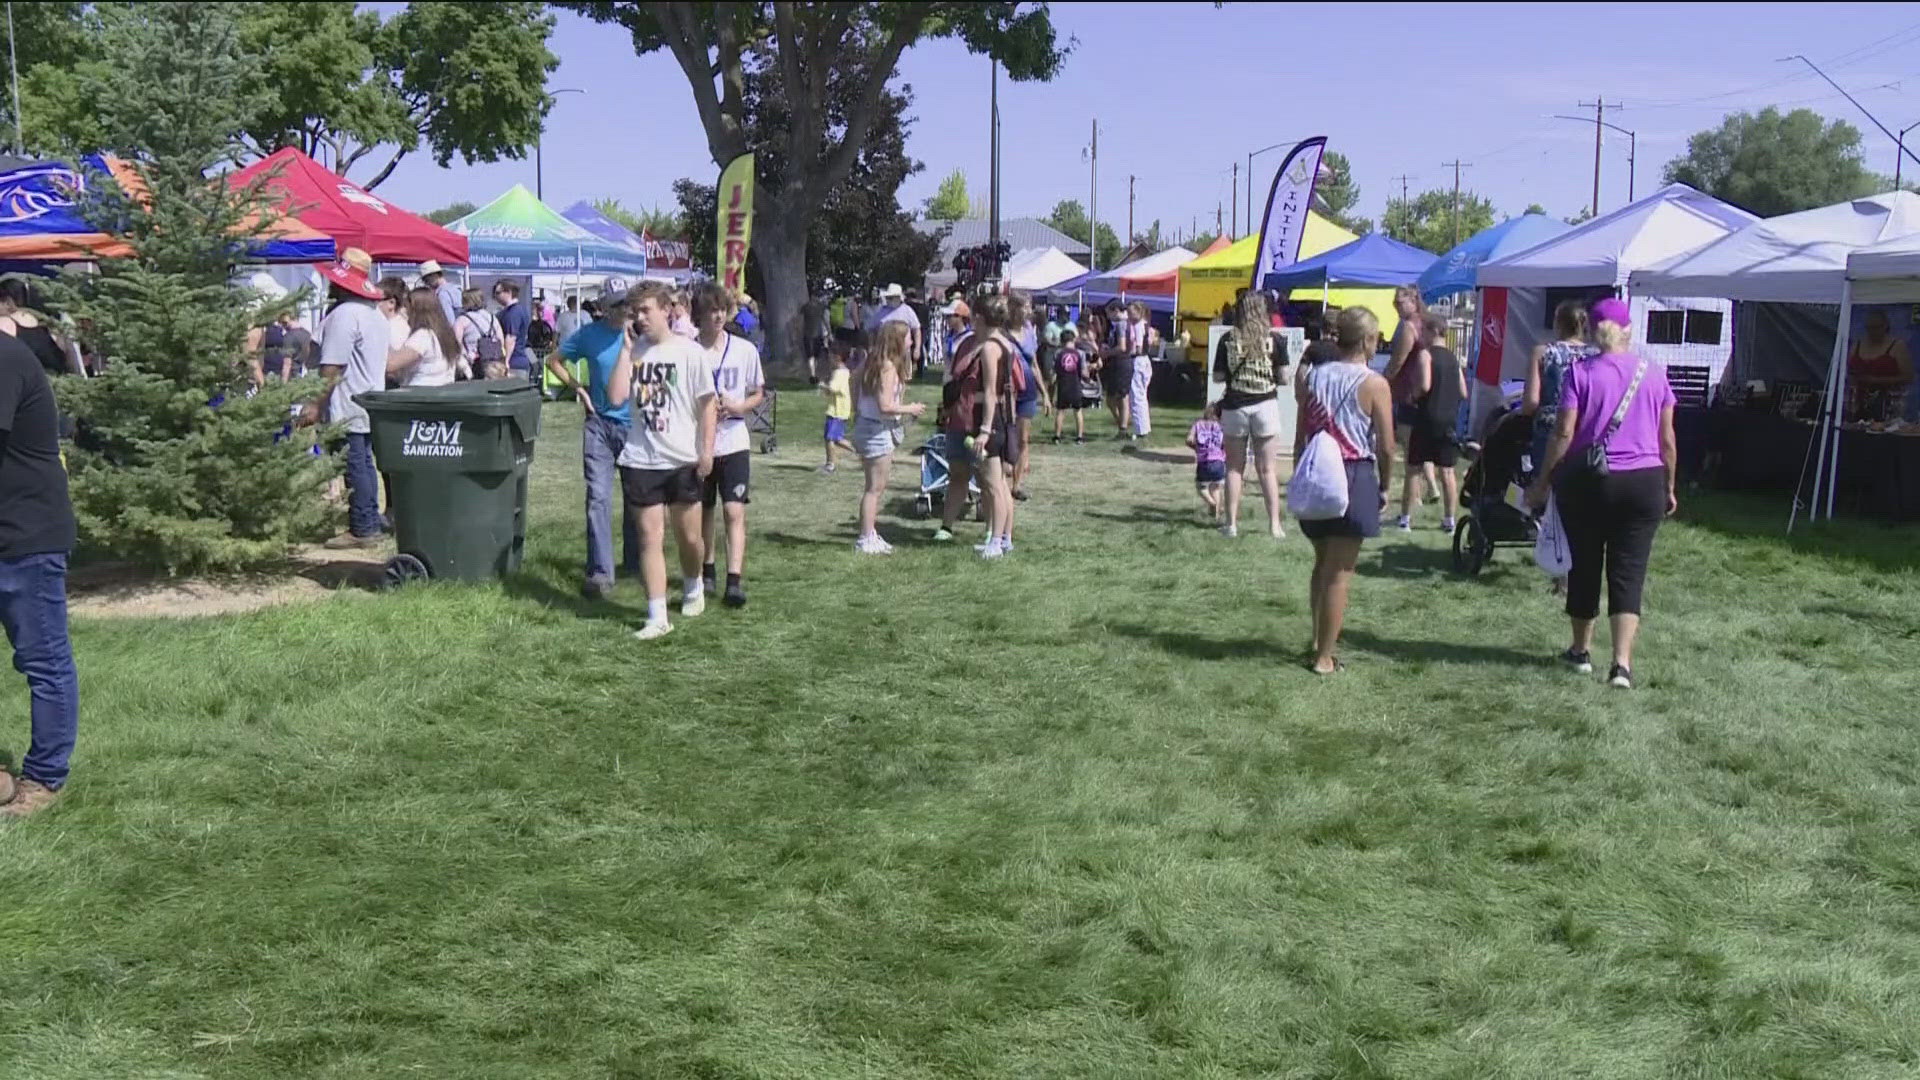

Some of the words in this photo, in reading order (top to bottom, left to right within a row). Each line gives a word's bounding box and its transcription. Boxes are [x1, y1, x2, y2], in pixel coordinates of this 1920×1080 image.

[1271, 191, 1296, 271] INITIAL
[631, 362, 676, 384] JUST
[403, 420, 462, 444] J&M
[403, 445, 463, 457] SANITATION
